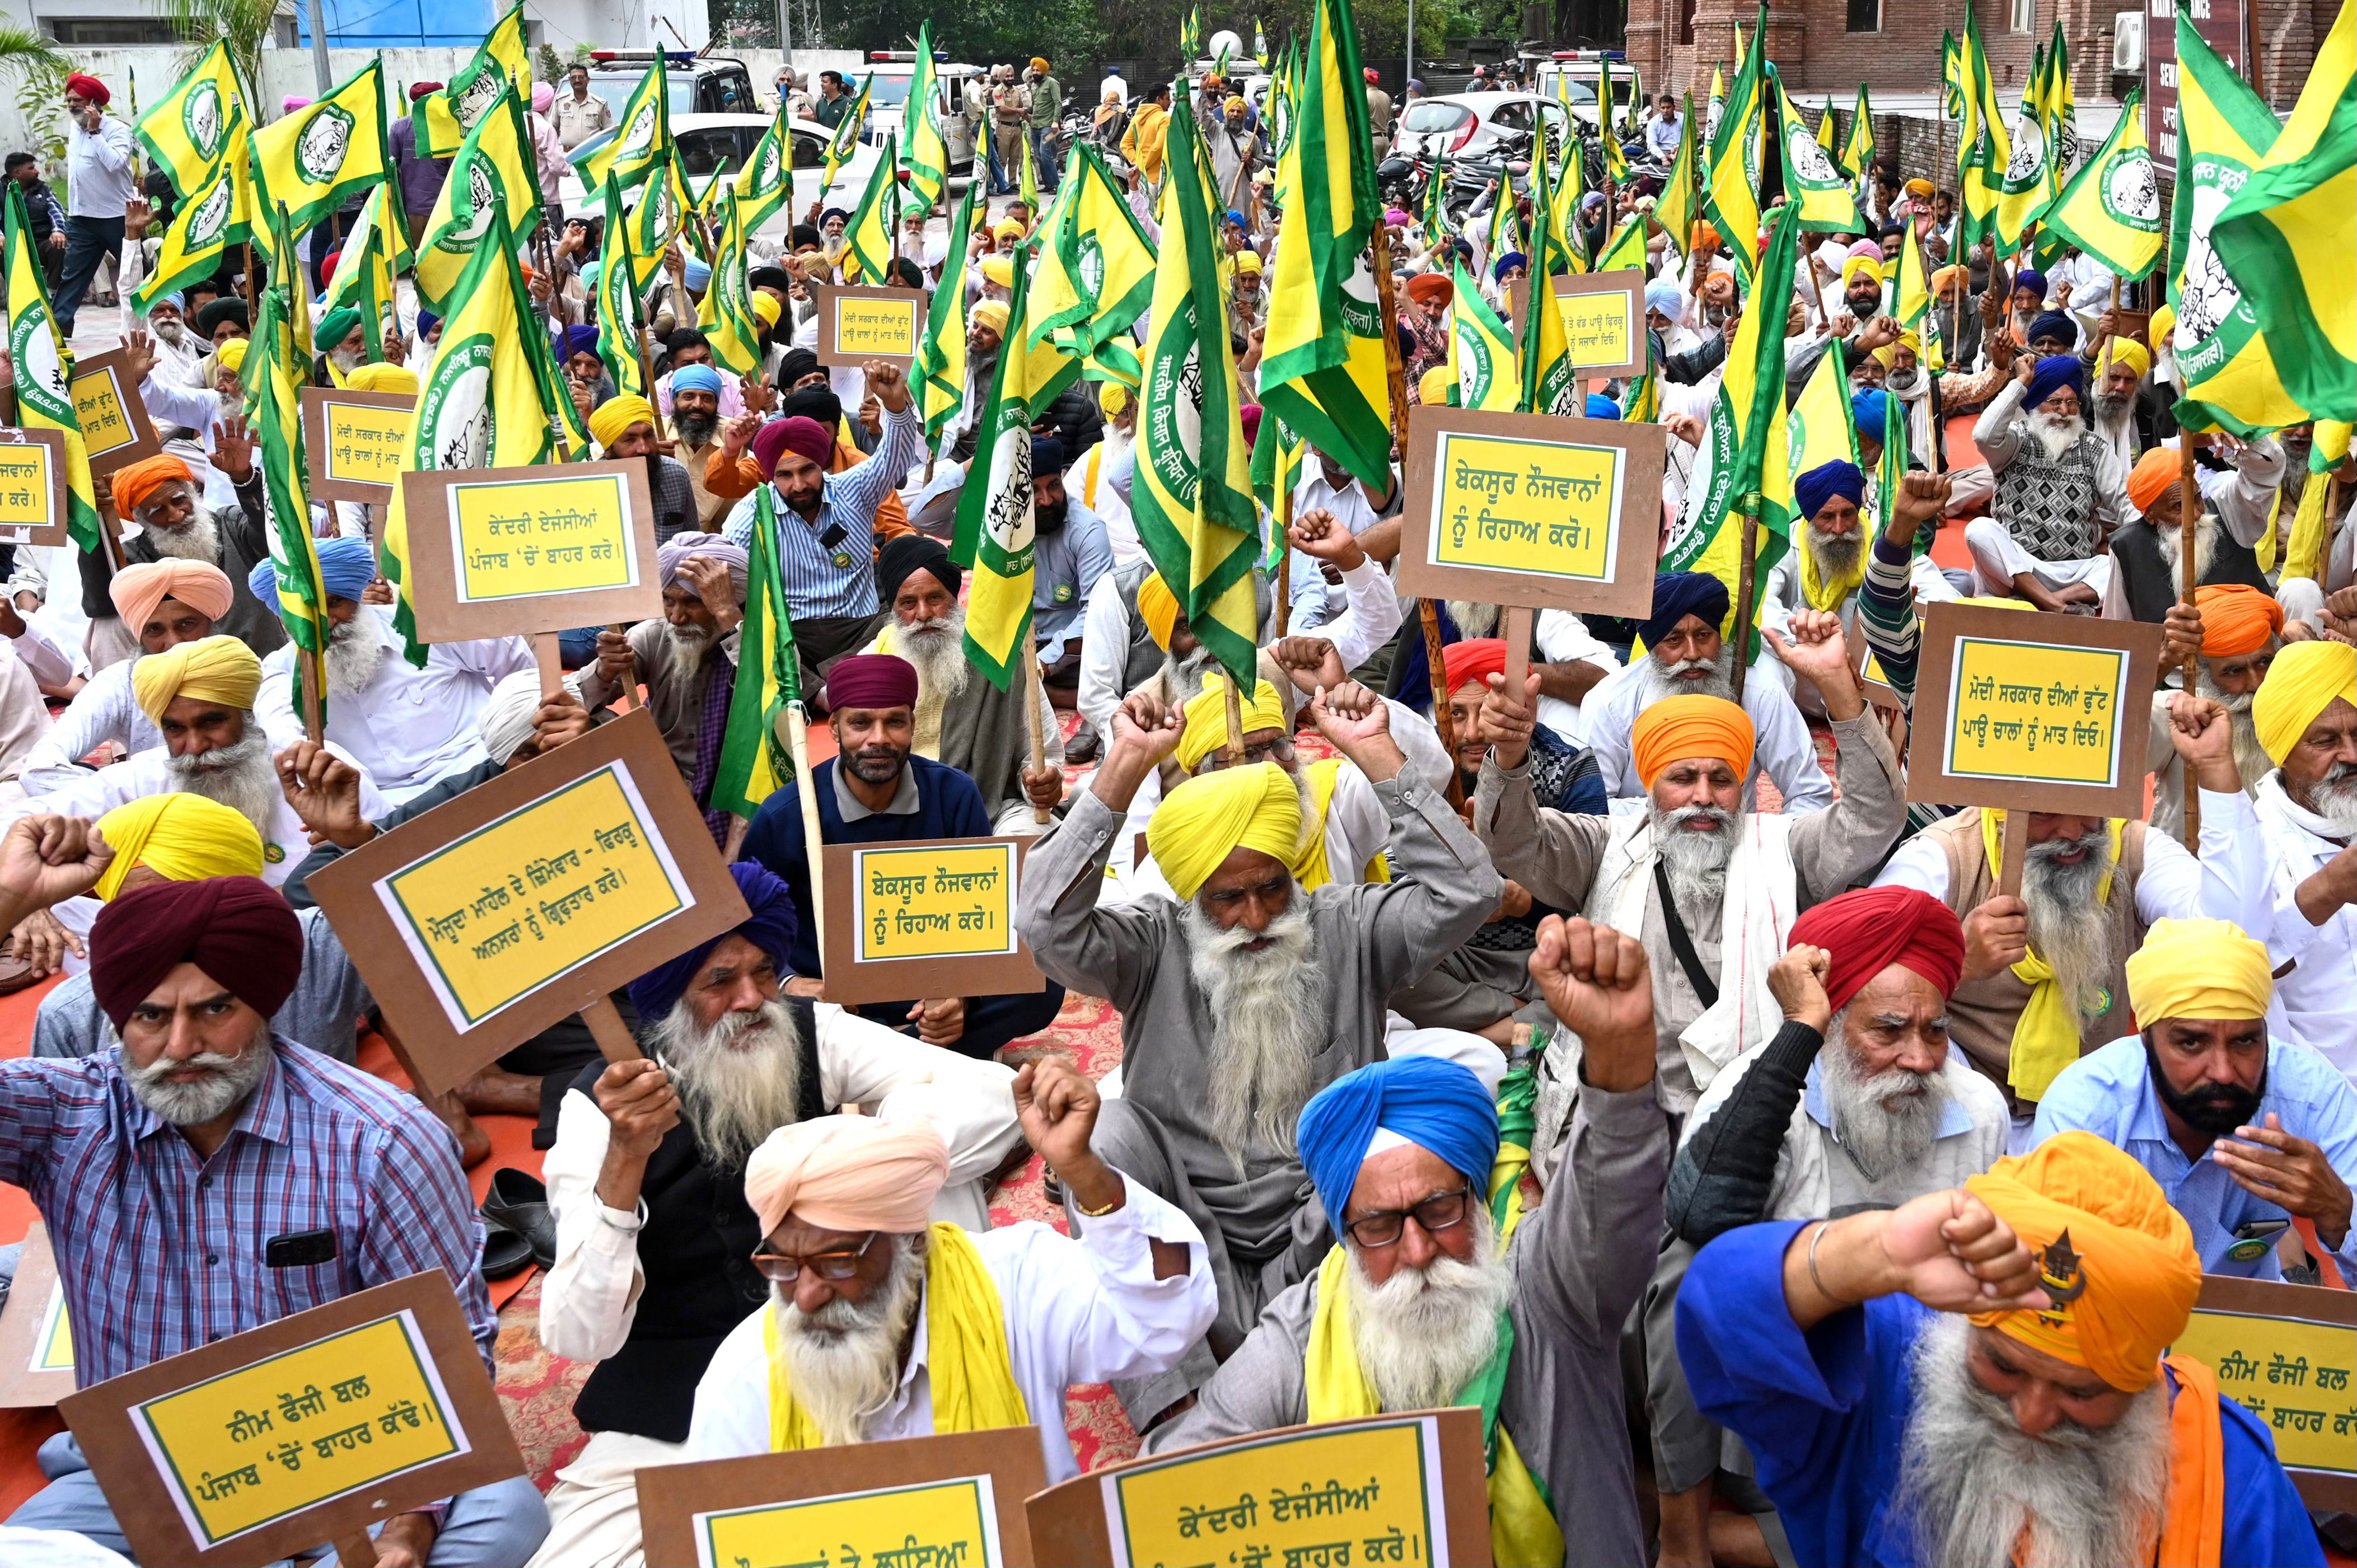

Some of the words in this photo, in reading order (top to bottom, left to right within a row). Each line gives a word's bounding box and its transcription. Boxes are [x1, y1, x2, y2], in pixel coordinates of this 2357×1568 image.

[2152, 0, 2171, 18] MAIN
[2172, 0, 2211, 19] EANCE
[1340, 301, 1373, 335] (एकता)
[1153, 354, 1172, 403] भारतीय
[355, 429, 382, 442] ਸਰਕਾਰ
[1152, 404, 1172, 448] किसान
[1153, 444, 1187, 485] यूनियन
[1455, 458, 1518, 505] ਬੇਕਸੂਰ
[1526, 463, 1602, 503] ਨੌਜਵਾਨਾਂ
[1704, 471, 1732, 526] (ਏਕਤਾ)
[488, 512, 532, 536] ਕੇਂਦਰੀ
[538, 508, 597, 532] ਏਜੰਸੀਆਂ
[1452, 504, 1469, 549] ਨੂੰ
[1477, 507, 1541, 544] ਰਿਹਾਅ
[469, 548, 509, 570] ਪੰਜਾਬ
[546, 546, 583, 564] ਬਾਹਰ
[1968, 673, 1995, 701] ਮੋਦੀ
[1999, 684, 2043, 705] ਸਰਕਾਰ
[2047, 681, 2080, 708] ਦੀਆਂ
[2083, 684, 2109, 715] ਫੁੱਟ
[1963, 713, 1989, 748] ਪਾਊ
[1993, 718, 2023, 741] ਚਾਲਾਂ
[2027, 716, 2039, 752] ਨੂੰ
[2043, 725, 2069, 745] ਮਾਤ
[871, 870, 928, 905] ਬੇਕਸੂਰ
[934, 865, 999, 893] ਨੌਜਵਾਨਾਂ
[425, 908, 467, 944] ਮੌਜੂਦਾ
[469, 887, 511, 919] ਮਾਹੌਲ
[507, 874, 527, 896] ਦੇ
[873, 908, 888, 946] ਨੂੰ
[895, 907, 951, 935] ਰਿਹਾਅ
[471, 918, 522, 959] ਅਨਸਰਾਂ
[523, 907, 545, 941] ਨੂੰ
[2219, 1350, 2261, 1382] ਨੀਮ
[2267, 1351, 2309, 1387] ਫੌਜੀ
[2315, 1366, 2351, 1391] ਬਲ
[225, 1409, 274, 1443] ਨੀਮ
[277, 1384, 326, 1423] ਫੌਜੀ
[330, 1374, 371, 1403] ਬਲ
[2271, 1407, 2327, 1434] ਬਾਹਰ
[195, 1463, 262, 1501] ਪੰਜਾਬ
[311, 1421, 373, 1459] ਬਾਹਰ
[1177, 1492, 1259, 1539] ਕੇਂਦਰੀ
[1269, 1476, 1380, 1523] ਏਜੰਸੀਆਂ
